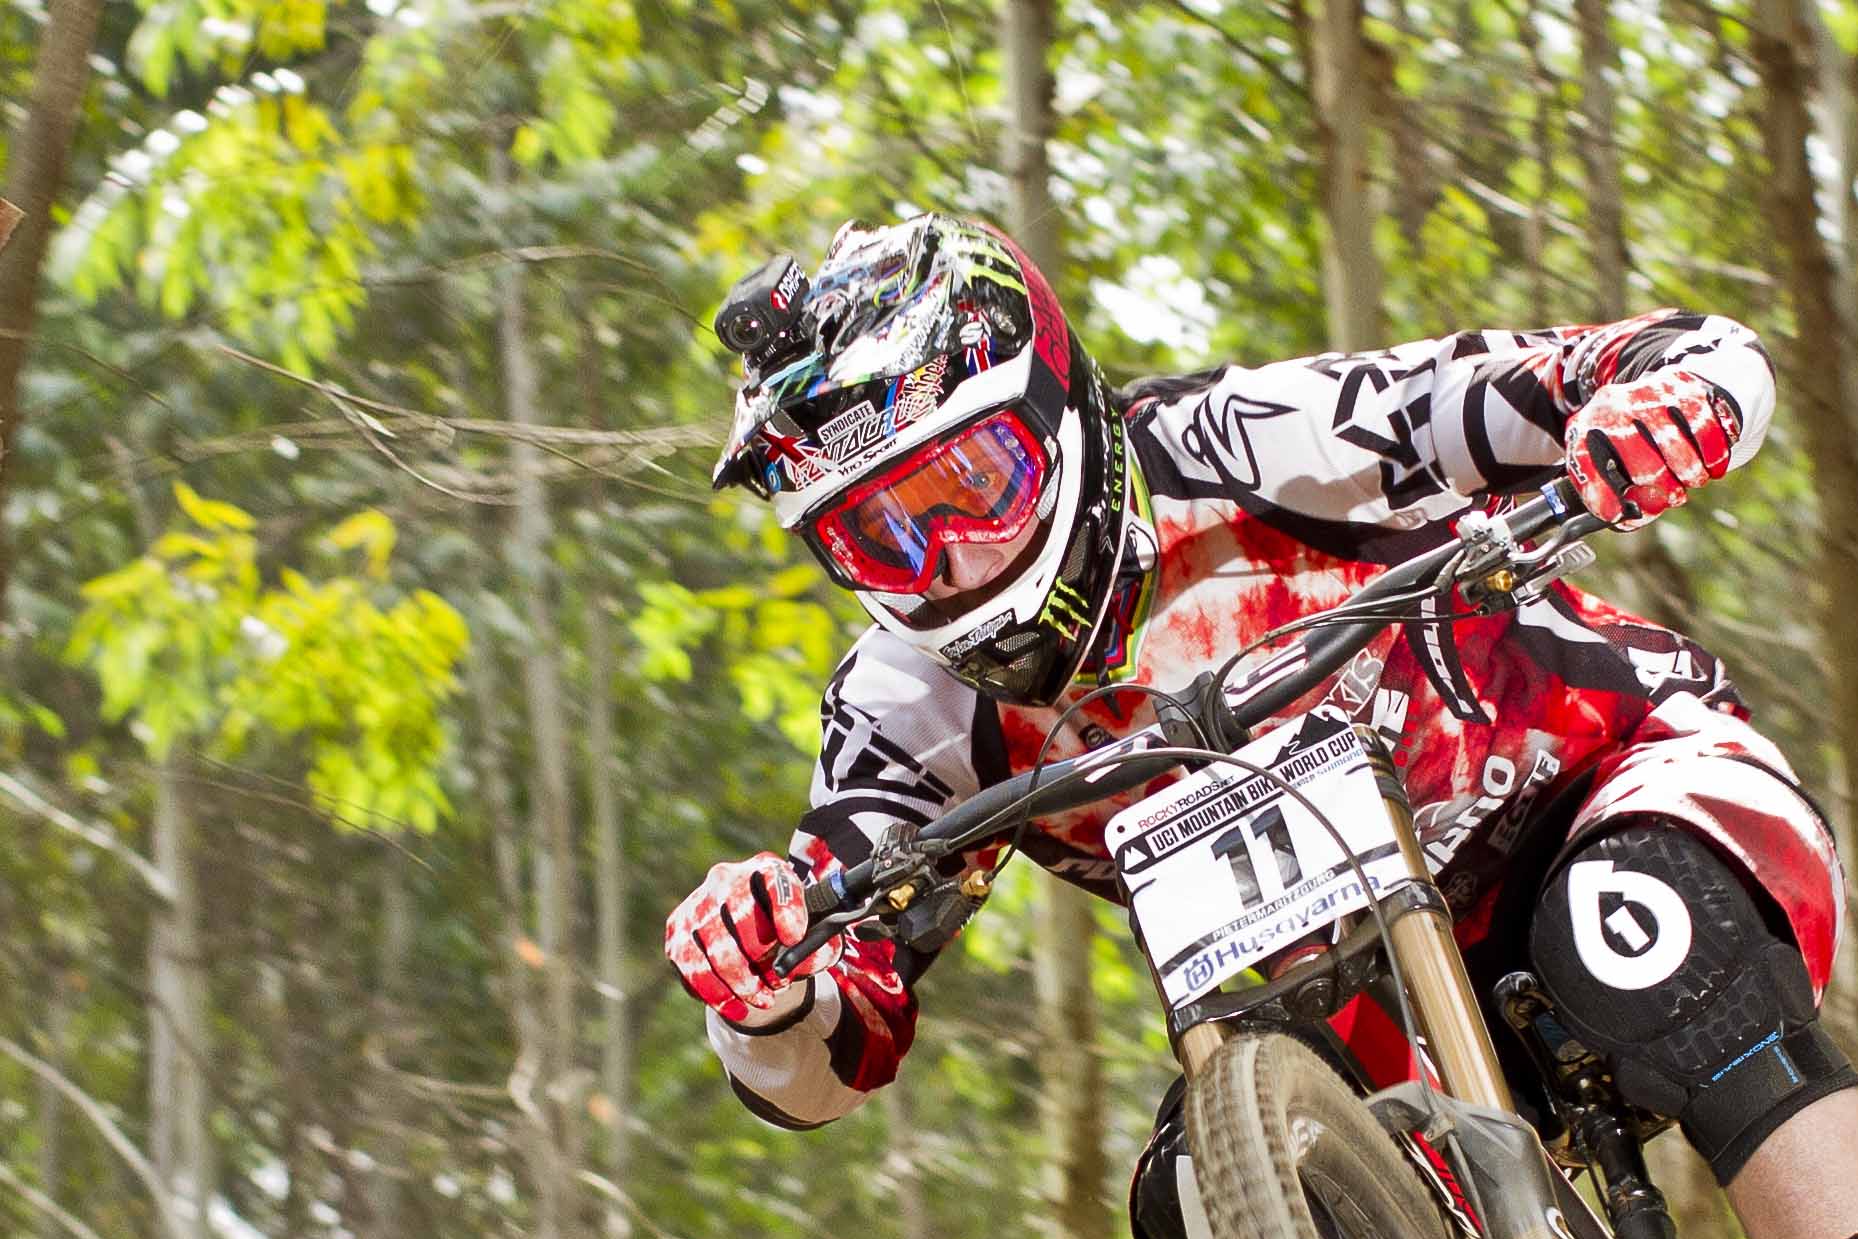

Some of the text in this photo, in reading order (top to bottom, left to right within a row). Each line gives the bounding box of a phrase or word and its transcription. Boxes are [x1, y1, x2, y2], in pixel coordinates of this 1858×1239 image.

[820, 403, 873, 441] SYNDICATE
[1109, 404, 1124, 513] ENERGY
[1152, 830, 1180, 852] UCI
[1176, 790, 1249, 838] MOUNTAIN
[1280, 747, 1329, 783] WORLD
[1328, 731, 1356, 757] CUP
[1210, 804, 1303, 910] 11
[1215, 876, 1381, 969] Husqvarna
